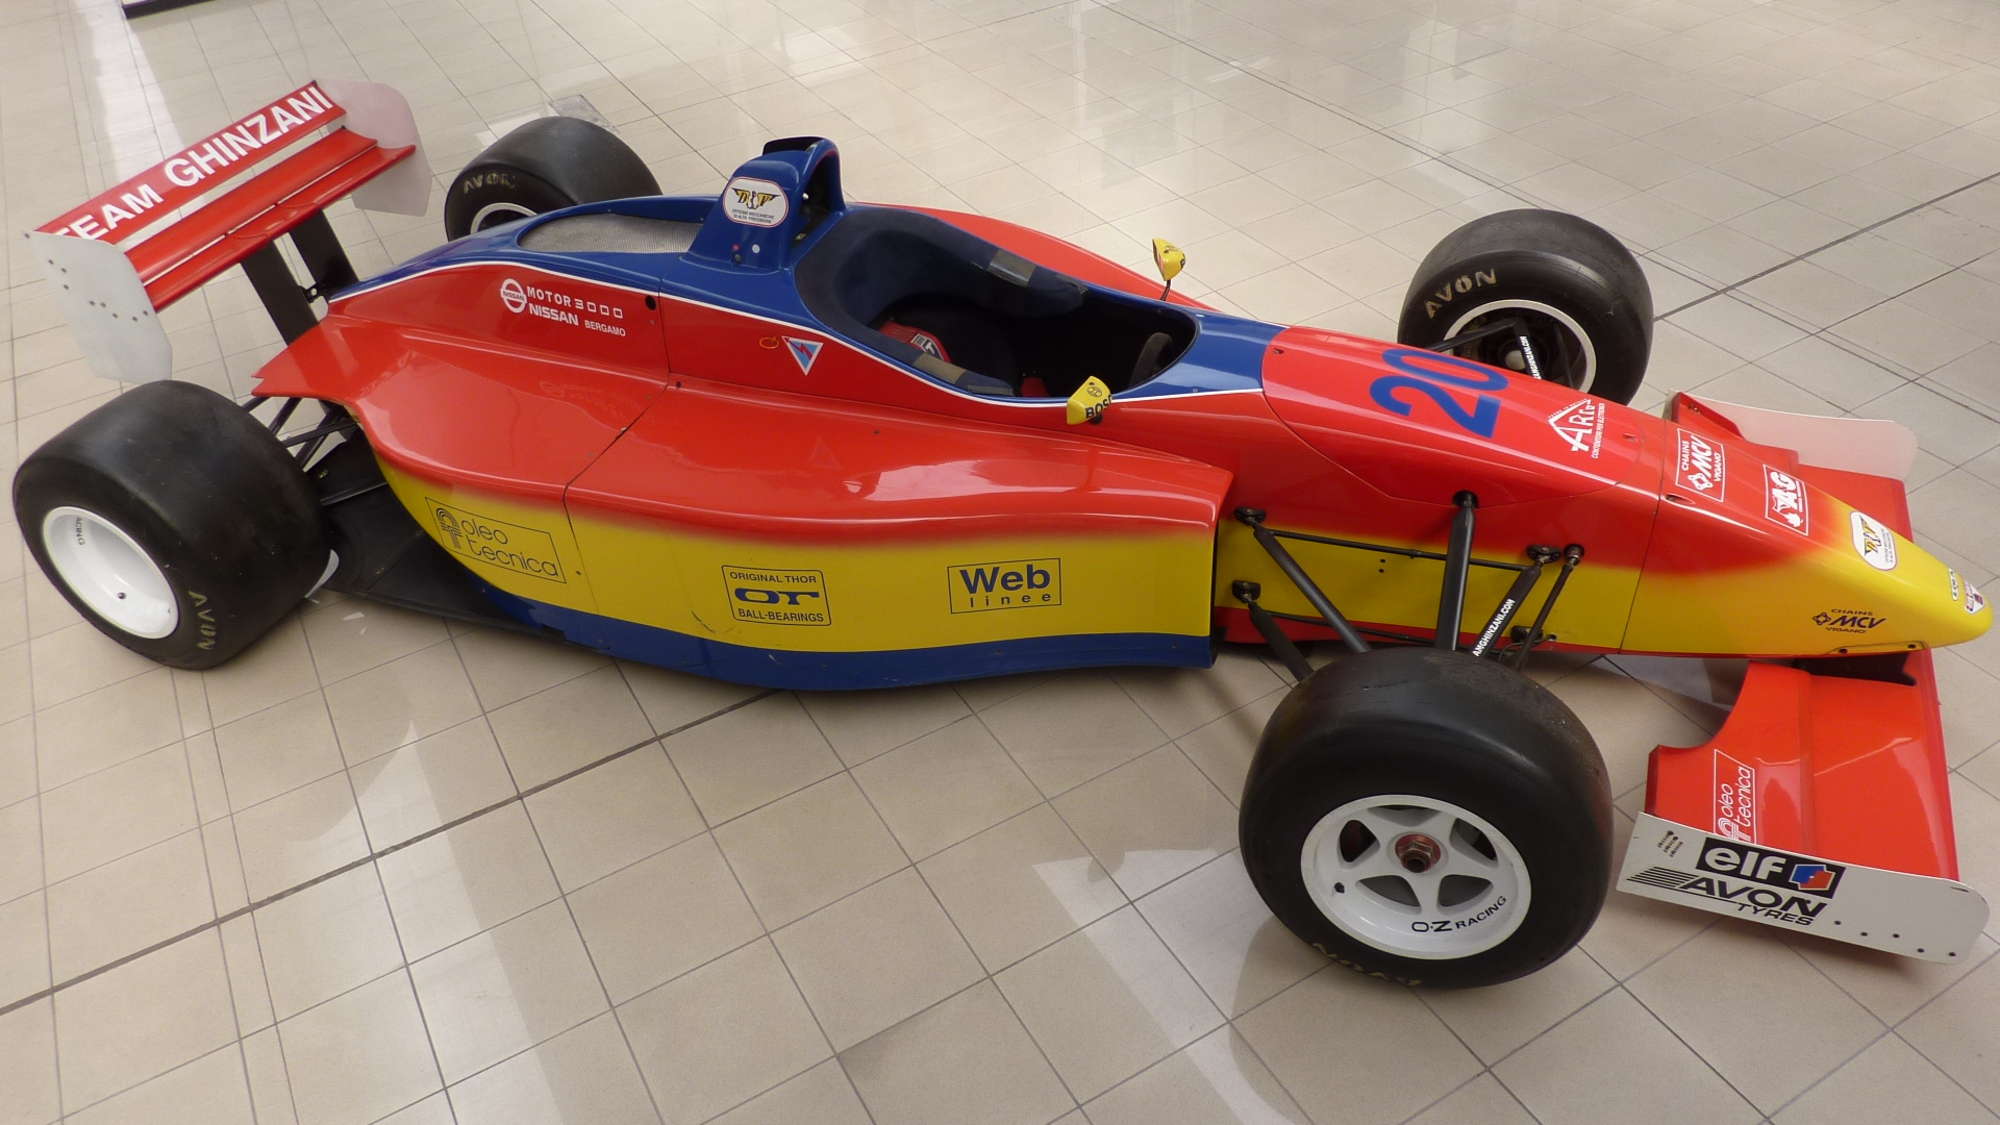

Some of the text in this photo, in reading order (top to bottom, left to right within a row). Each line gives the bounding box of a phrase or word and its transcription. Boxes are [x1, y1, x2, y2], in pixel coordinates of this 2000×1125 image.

[164, 86, 333, 187] GHINZANI
[527, 286, 572, 308] MOTOR
[1424, 268, 1497, 319] AVON
[529, 303, 626, 337] NISSAN BERGAMO
[1369, 348, 1509, 439] 20
[461, 518, 509, 545] oleo
[465, 534, 559, 577] tecnica
[729, 571, 817, 584] ORIGINAL THOR
[960, 564, 1051, 594] Web
[738, 608, 824, 622] BALL-BEARINGS
[1828, 615, 1887, 629] MCV
[1704, 847, 1787, 881] elf
[1455, 895, 1507, 930] RACING
[1680, 876, 1828, 918] AVON
[1738, 902, 1814, 926] TYRES
